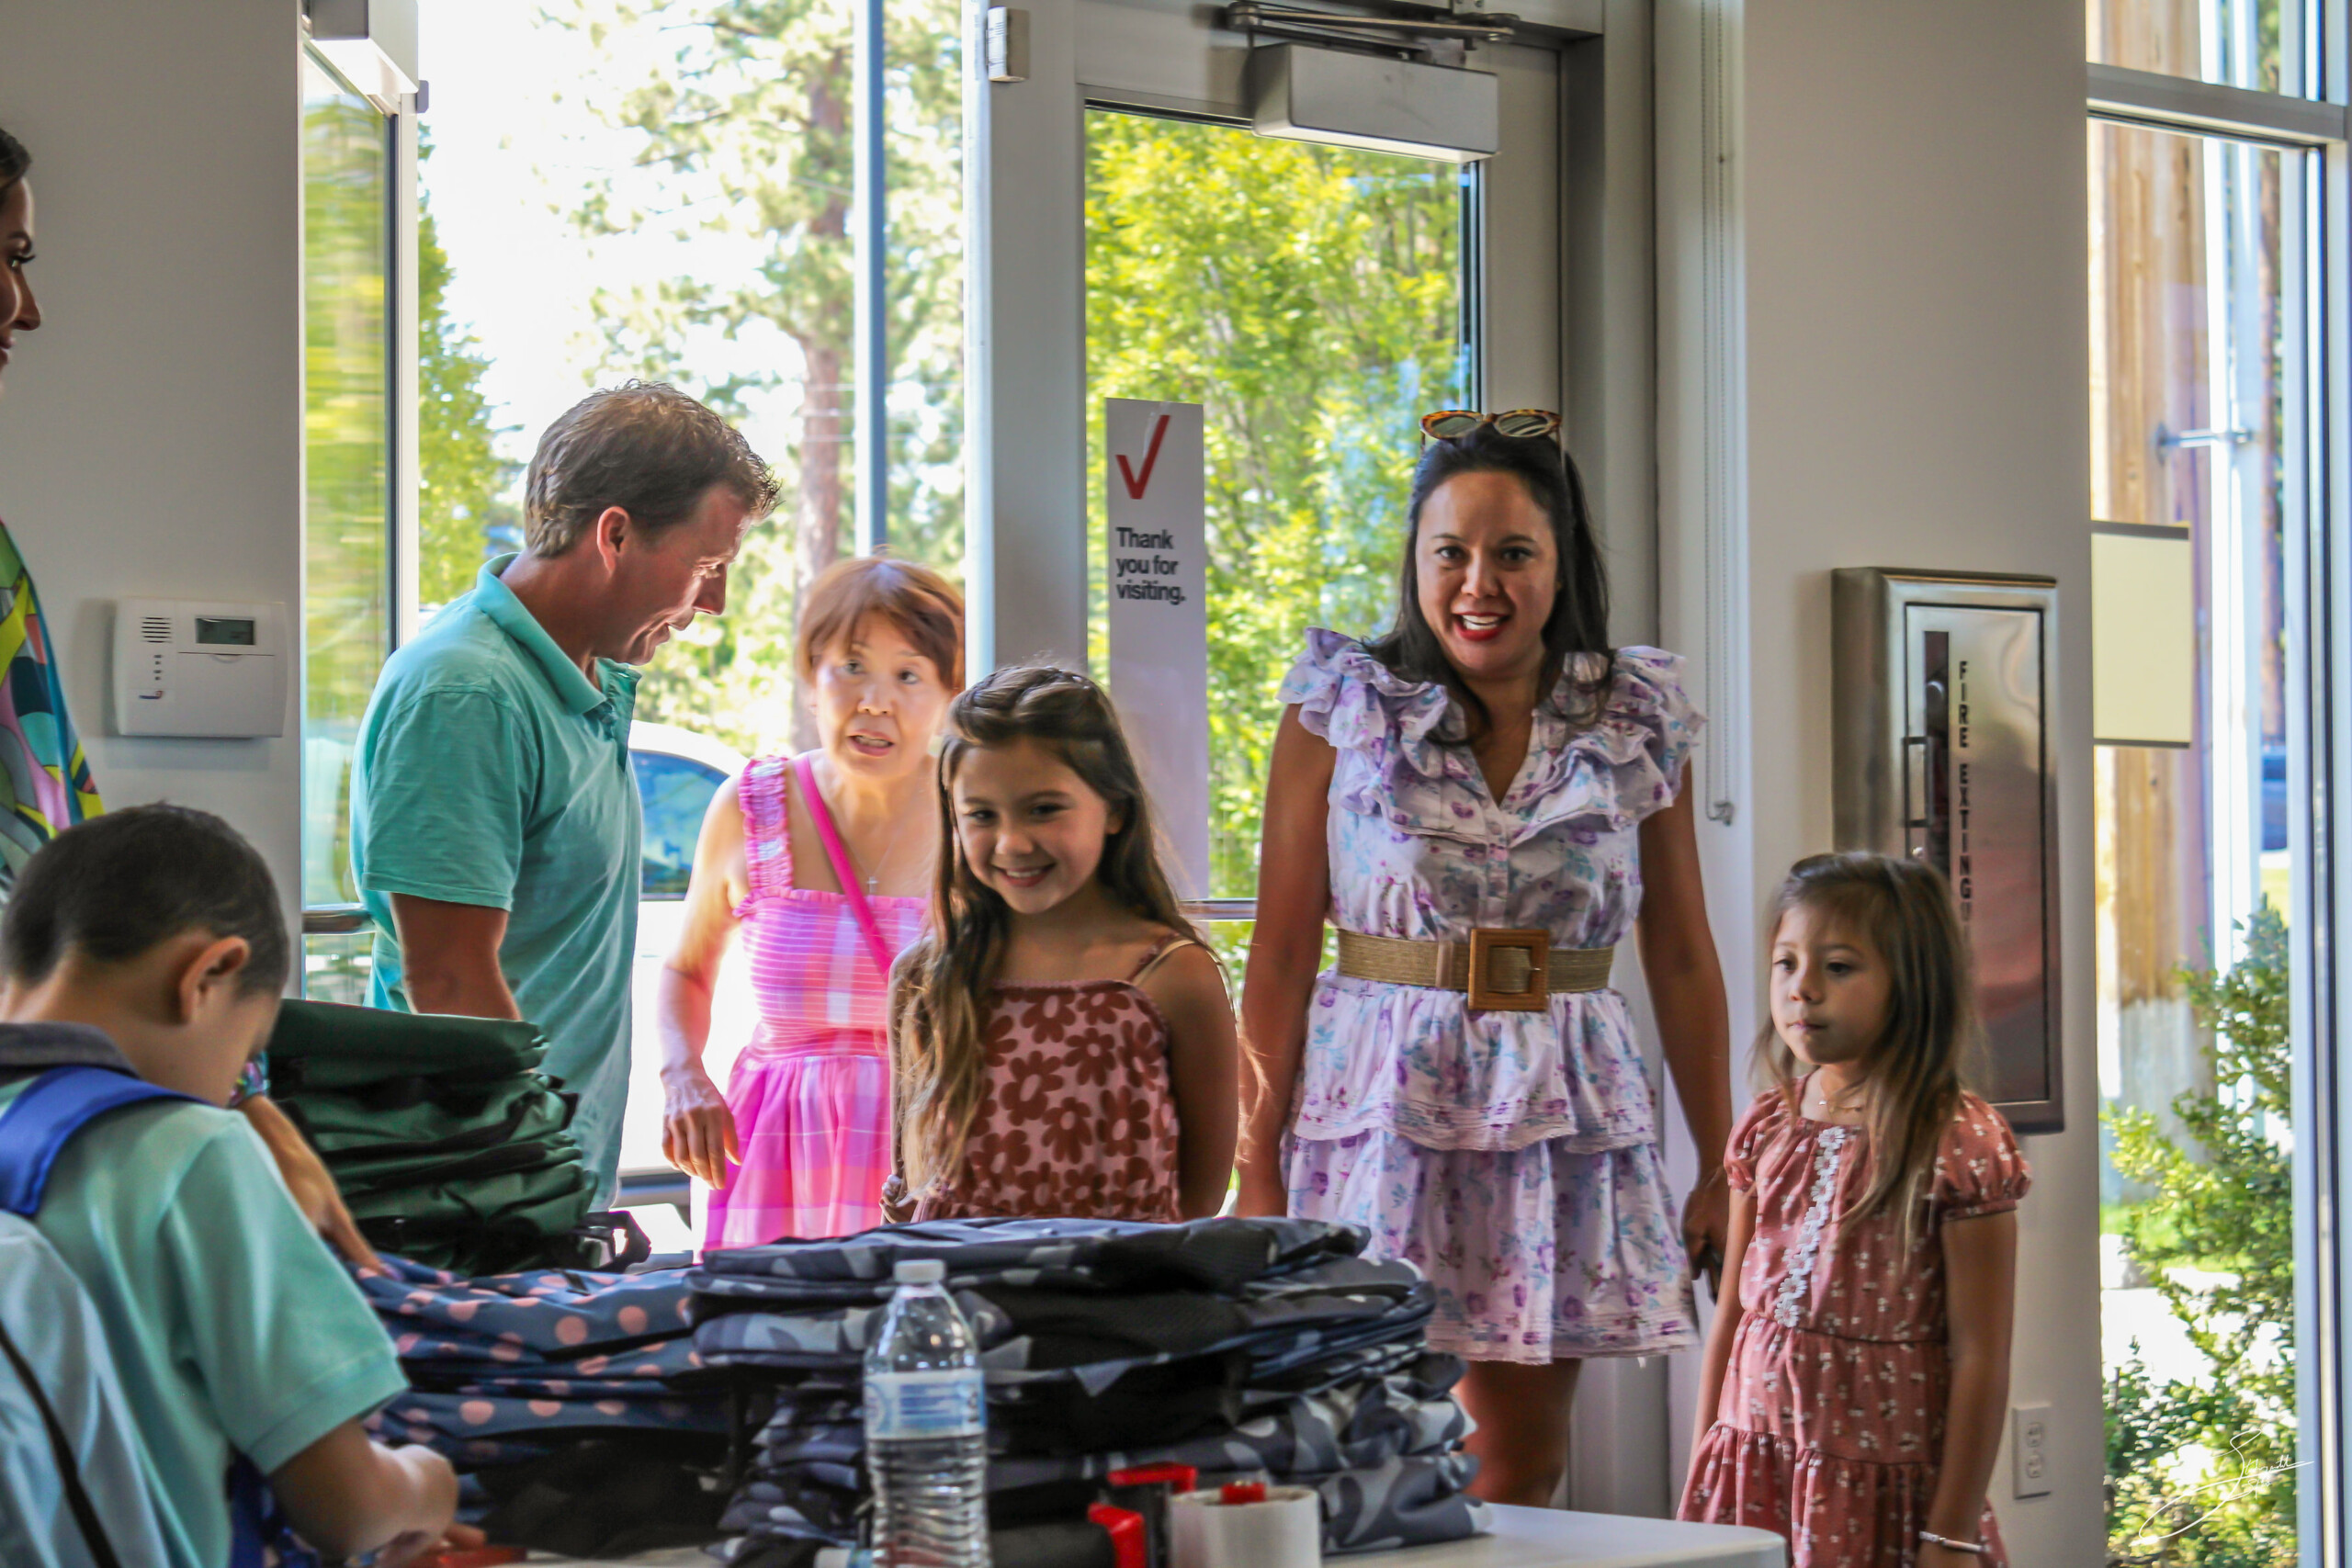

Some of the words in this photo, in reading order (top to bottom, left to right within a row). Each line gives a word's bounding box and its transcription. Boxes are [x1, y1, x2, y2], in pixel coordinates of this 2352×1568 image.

[1115, 526, 1174, 549] Thank
[1115, 558, 1149, 578] you
[1152, 555, 1180, 576] for
[1115, 579, 1187, 605] visiting.
[1958, 660, 1971, 749] FIRE
